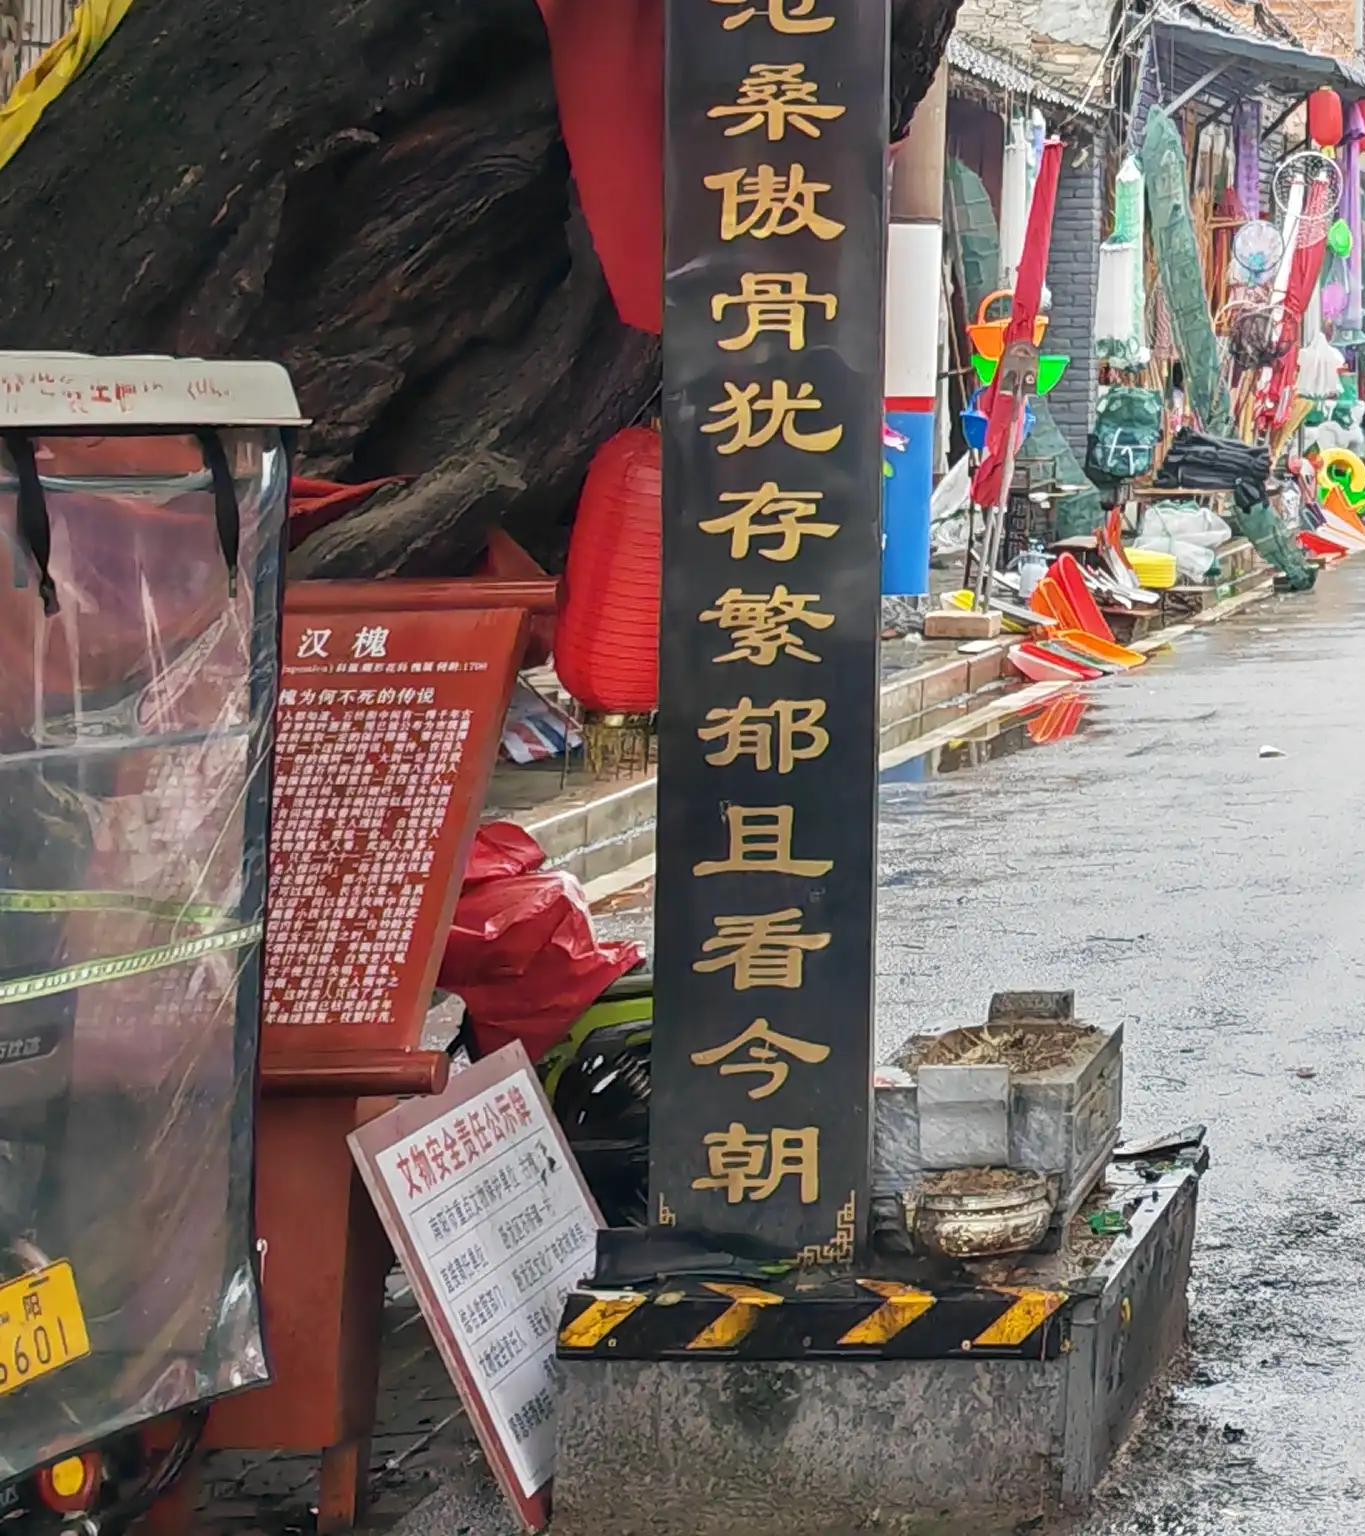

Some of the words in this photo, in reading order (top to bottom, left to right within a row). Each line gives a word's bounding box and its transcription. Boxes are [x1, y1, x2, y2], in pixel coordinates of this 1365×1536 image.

[297, 625, 390, 658] 汉槐
[396, 1085, 533, 1200] 文物安全责任公示牌
